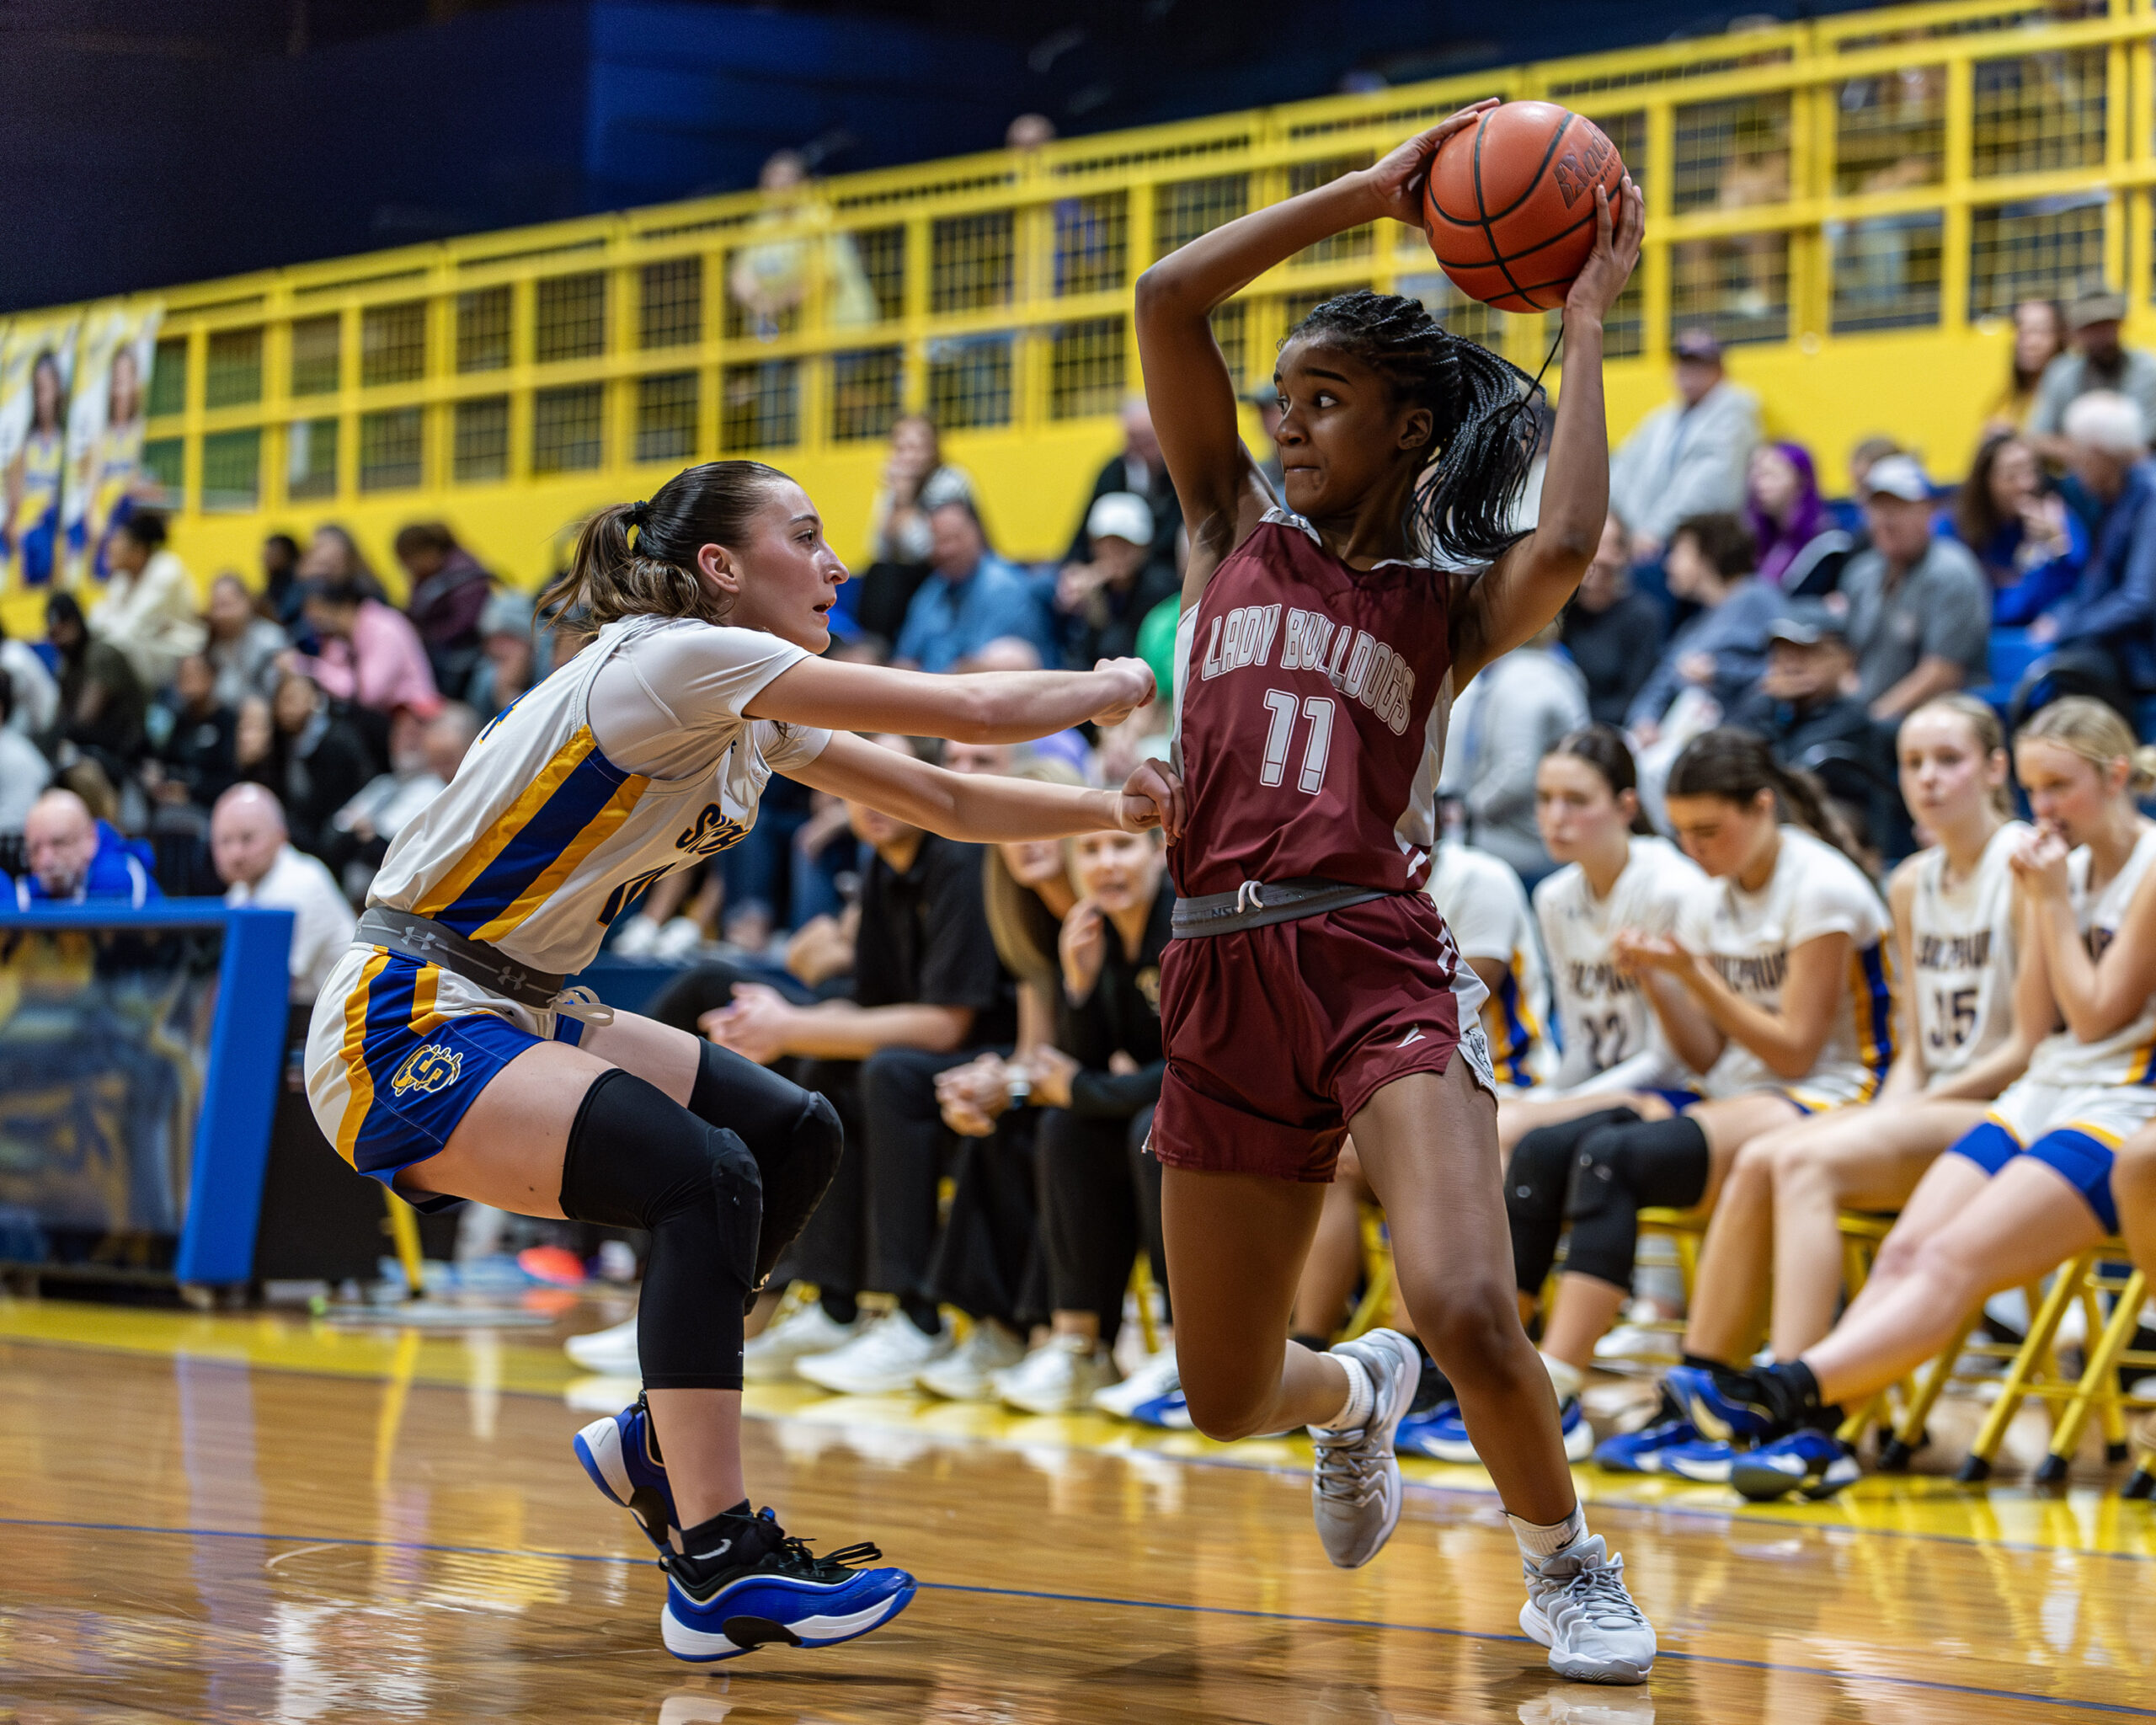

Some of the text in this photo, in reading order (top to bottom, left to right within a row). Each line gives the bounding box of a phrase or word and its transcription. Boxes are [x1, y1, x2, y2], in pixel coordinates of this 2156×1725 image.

[1201, 603, 1416, 735] LADY BULLDOGS
[1260, 688, 1335, 795] 11
